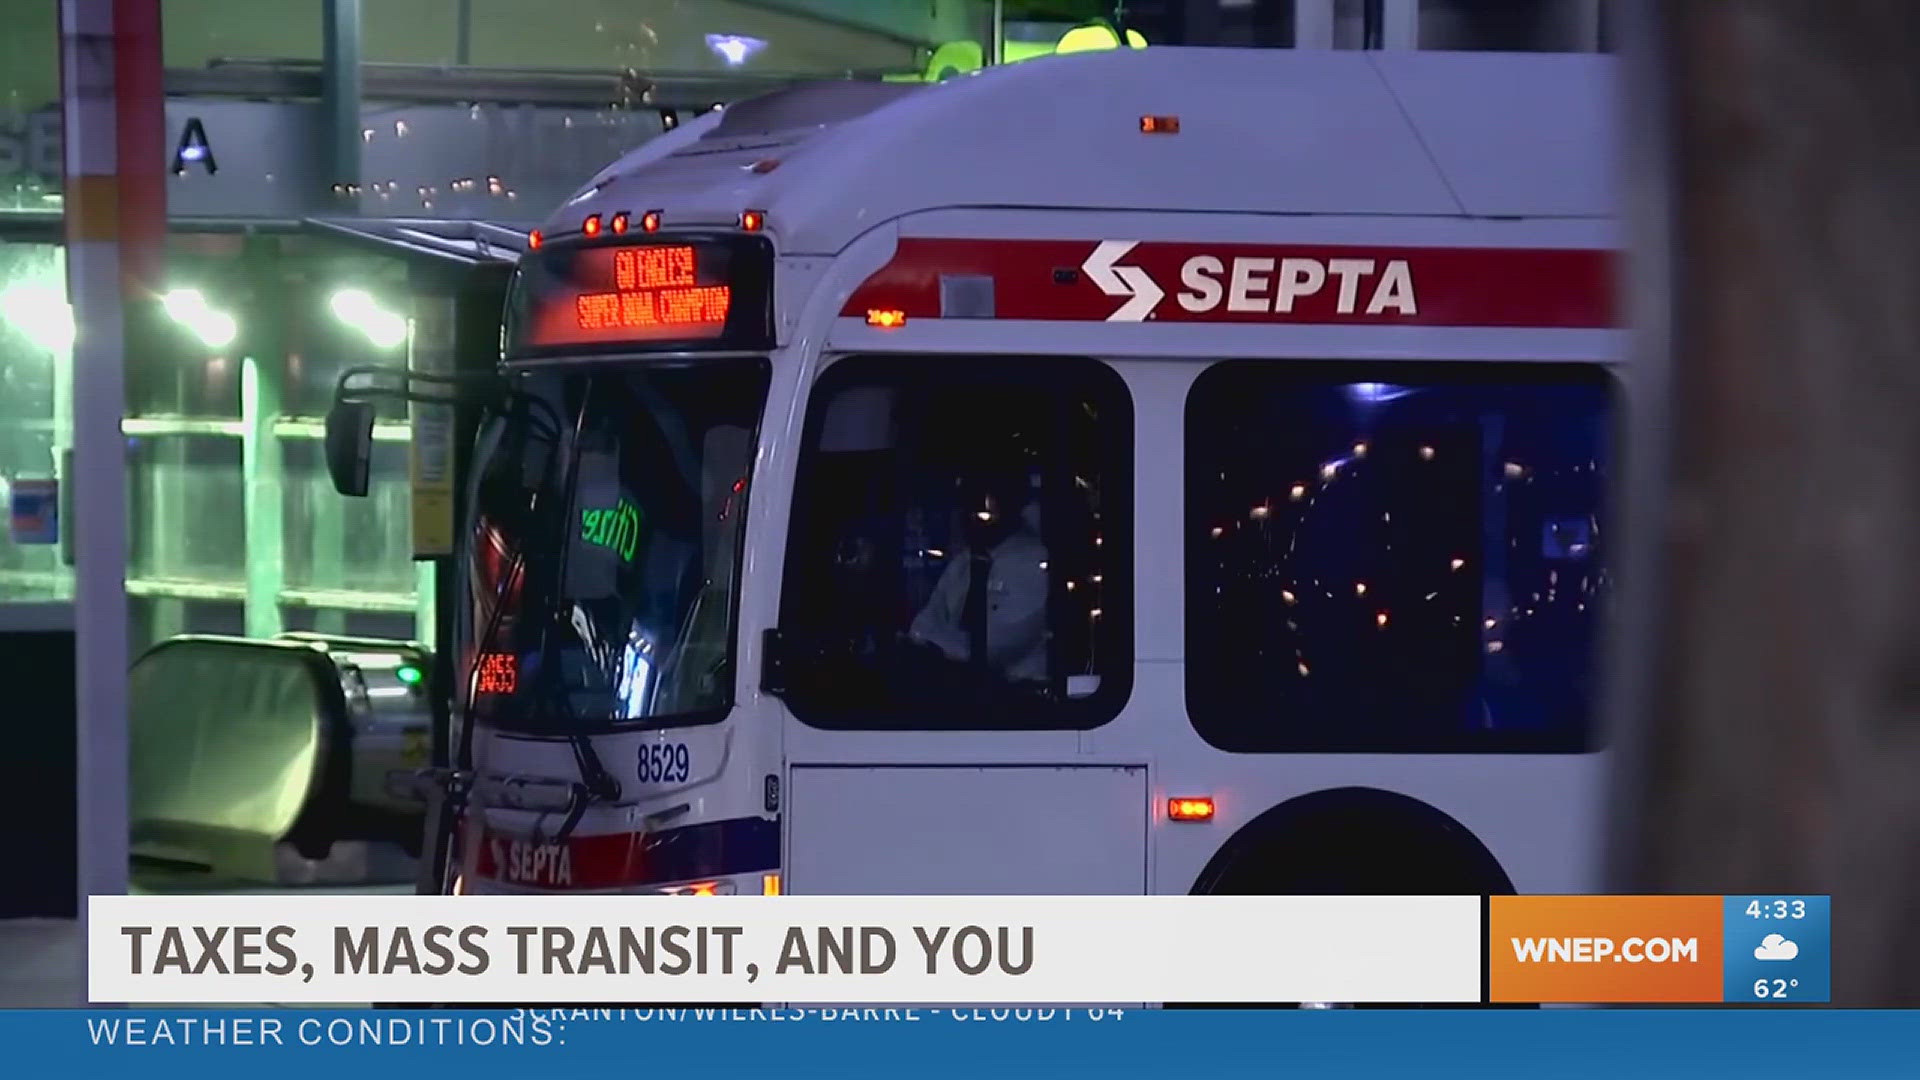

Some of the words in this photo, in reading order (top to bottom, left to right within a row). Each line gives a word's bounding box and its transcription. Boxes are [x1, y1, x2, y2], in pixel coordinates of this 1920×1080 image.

[1177, 255, 1417, 314] SEPTA
[577, 294, 620, 329] SUPER
[637, 743, 689, 783] 8529
[509, 839, 571, 885] SEPTA
